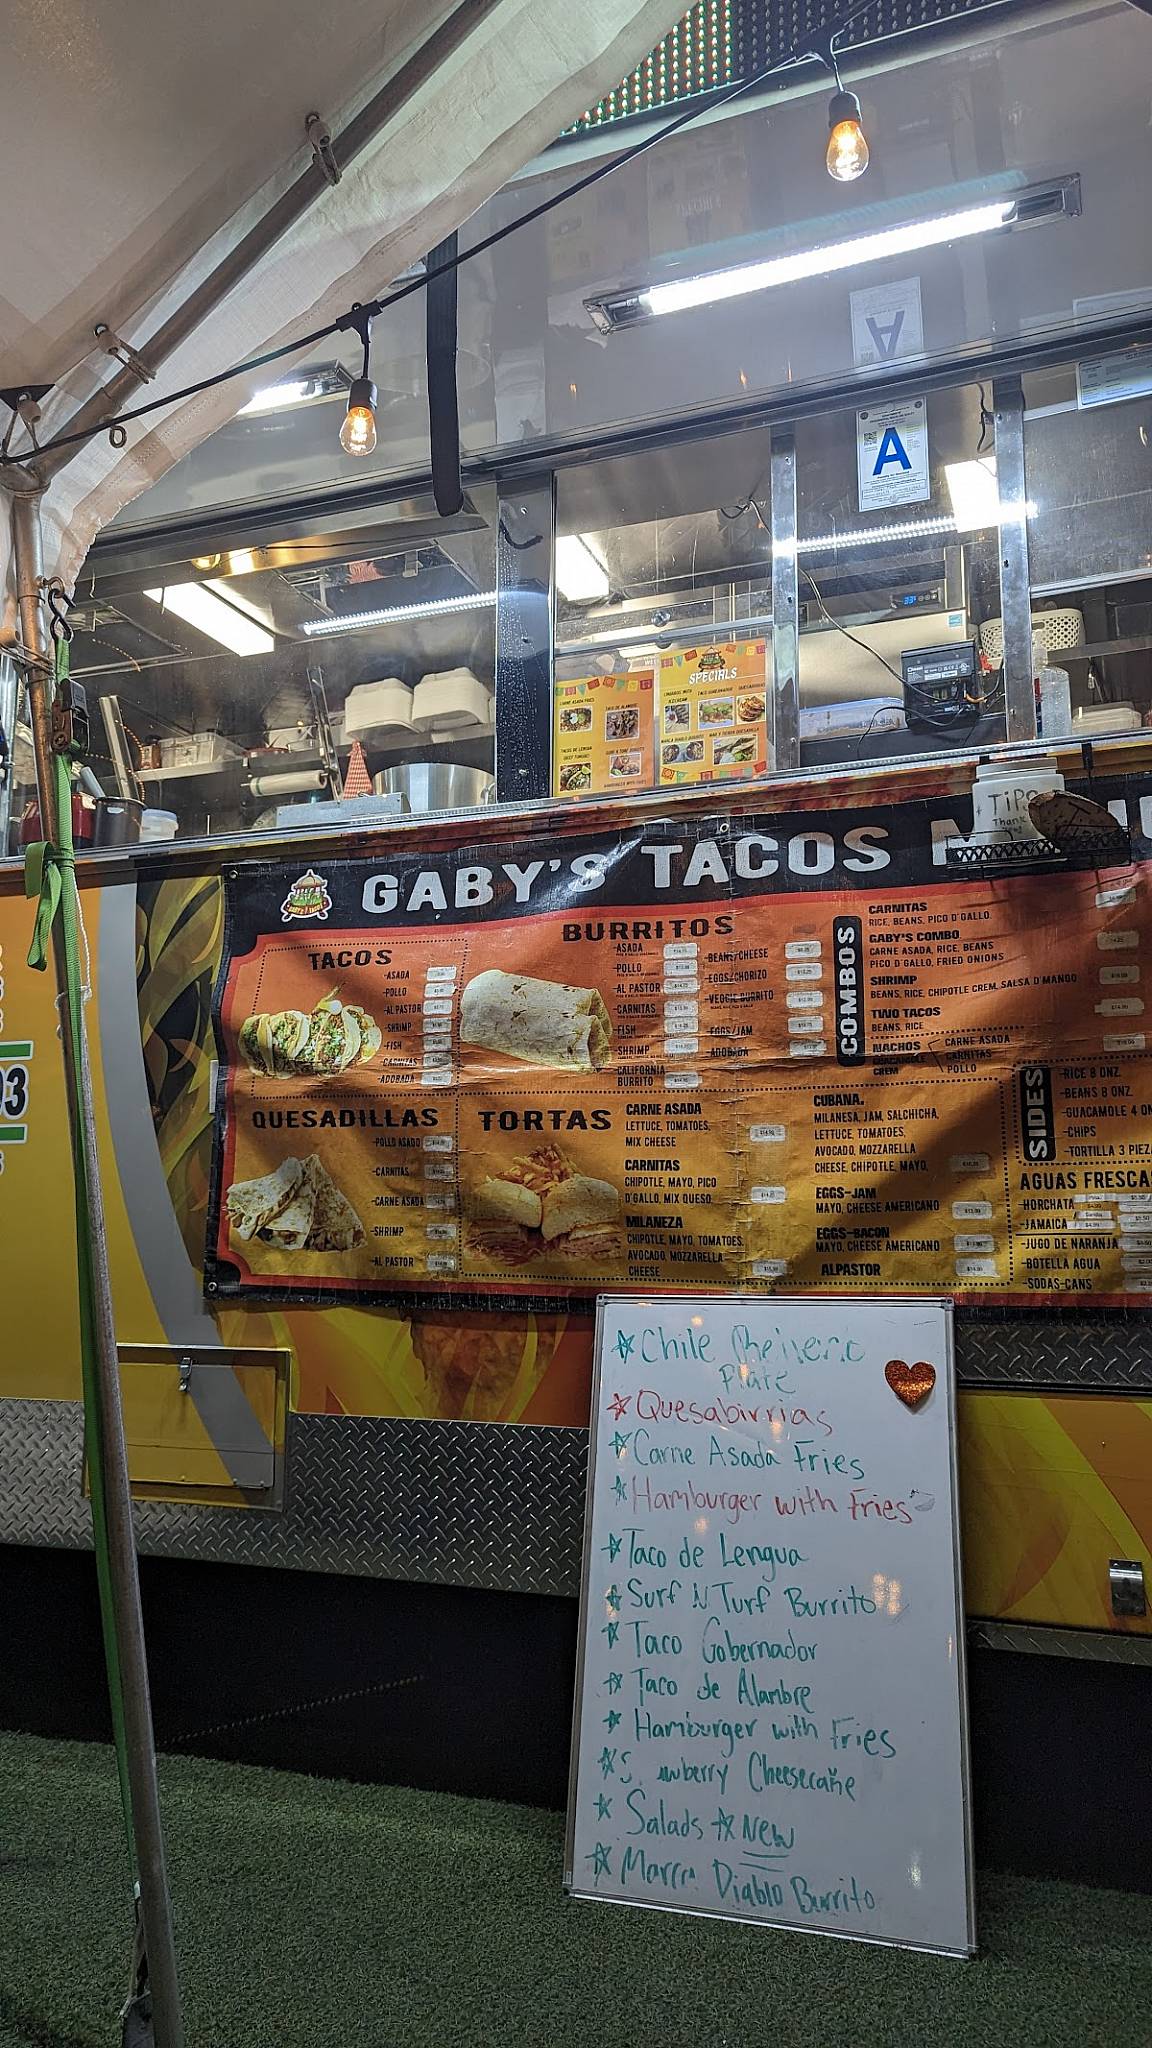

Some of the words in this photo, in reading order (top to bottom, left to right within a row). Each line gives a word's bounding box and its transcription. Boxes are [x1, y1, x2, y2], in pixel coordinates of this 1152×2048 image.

[872, 426, 913, 477] A
[688, 667, 737, 686] SPECIALS
[361, 852, 606, 914] GABY'S
[641, 826, 891, 889] TACOS
[869, 902, 928, 914] CARNITAS
[928, 914, 948, 924] PICO
[561, 916, 733, 941] BURRITOS
[869, 932, 913, 943] GABY'S
[869, 947, 898, 956] CARNE
[963, 941, 994, 951] BEANS
[308, 950, 393, 970] TACOS
[870, 959, 891, 968] PICO
[937, 956, 964, 966] FRIED
[967, 953, 1004, 964] ONIONS
[629, 983, 661, 993] PASTOR
[870, 976, 918, 986] SHRIMP
[928, 986, 969, 997] CHIPOTLE
[1001, 977, 1030, 988] SALSA
[837, 926, 858, 1056] COMBOS
[871, 1009, 900, 1019] TWO
[902, 1006, 941, 1017] TACOS
[905, 1021, 924, 1030] RICE
[872, 1041, 921, 1052] NACHOS
[944, 1037, 977, 1047] CARNE
[978, 1034, 1011, 1045] ASADA
[947, 1063, 977, 1073] POLLO
[1090, 1067, 1097, 1078] 8
[617, 1077, 654, 1087] BURRITO
[1102, 1086, 1108, 1098] 8
[625, 1103, 662, 1115] CARNE
[664, 1102, 702, 1115] ASADA
[1025, 1068, 1048, 1159] SIDES
[1131, 1104, 1138, 1116] 4
[252, 1108, 439, 1129] QUESADILLAS
[478, 1109, 612, 1131] TORTAS
[625, 1136, 641, 1147] MIX
[644, 1136, 677, 1147] CHEESE
[859, 1142, 916, 1155] MOZZARELLA
[1119, 1144, 1125, 1155] 3
[624, 1159, 680, 1172] CARNITAS
[697, 1177, 717, 1188] PICO
[1020, 1171, 1077, 1191] AGUAS
[1083, 1170, 1152, 1189] FRESCA
[663, 1193, 680, 1204] MIX
[682, 1193, 712, 1204] QUESO
[815, 1186, 877, 1200] EGGS-JAM
[401, 1196, 425, 1207] ASADA
[846, 1201, 882, 1214] CHEESE
[884, 1200, 940, 1212] AMERICANO
[625, 1215, 683, 1229] MILANEZA
[847, 1239, 882, 1252] CHEESE
[885, 1239, 940, 1252] AMERICANO
[1054, 1238, 1068, 1250] DE
[1071, 1237, 1119, 1250] NARANJA
[385, 1256, 414, 1267] PASTOR
[670, 1250, 723, 1263] MOZZARELLA
[1073, 1257, 1101, 1270] AGUA
[628, 1265, 661, 1277] CHEESE
[641, 1326, 715, 1363] Chile
[636, 1389, 833, 1437] Quesabirrias
[634, 1428, 696, 1466] Carne
[709, 1435, 781, 1469] Asada
[794, 1440, 865, 1480] Fries
[631, 1474, 762, 1525] Hamburger
[775, 1485, 839, 1517] with
[848, 1487, 913, 1524] Fries
[622, 1528, 667, 1569] Taco
[679, 1536, 704, 1568] de
[719, 1532, 810, 1582] Lengua
[627, 1577, 683, 1609] Surf
[711, 1581, 773, 1613] Turf
[783, 1585, 877, 1618] Burrito
[625, 1620, 682, 1658] Taco
[702, 1616, 819, 1664] Gobernador
[631, 1667, 678, 1706] Taco
[697, 1673, 722, 1701] de
[738, 1668, 815, 1714] Alambre
[633, 1708, 758, 1758] Hamburger
[772, 1713, 819, 1741] with
[830, 1716, 897, 1759] Fries
[626, 1788, 704, 1841] Salads
[742, 1813, 795, 1849] New
[713, 1858, 785, 1908] Diablo
[790, 1875, 876, 1914] Burrito
